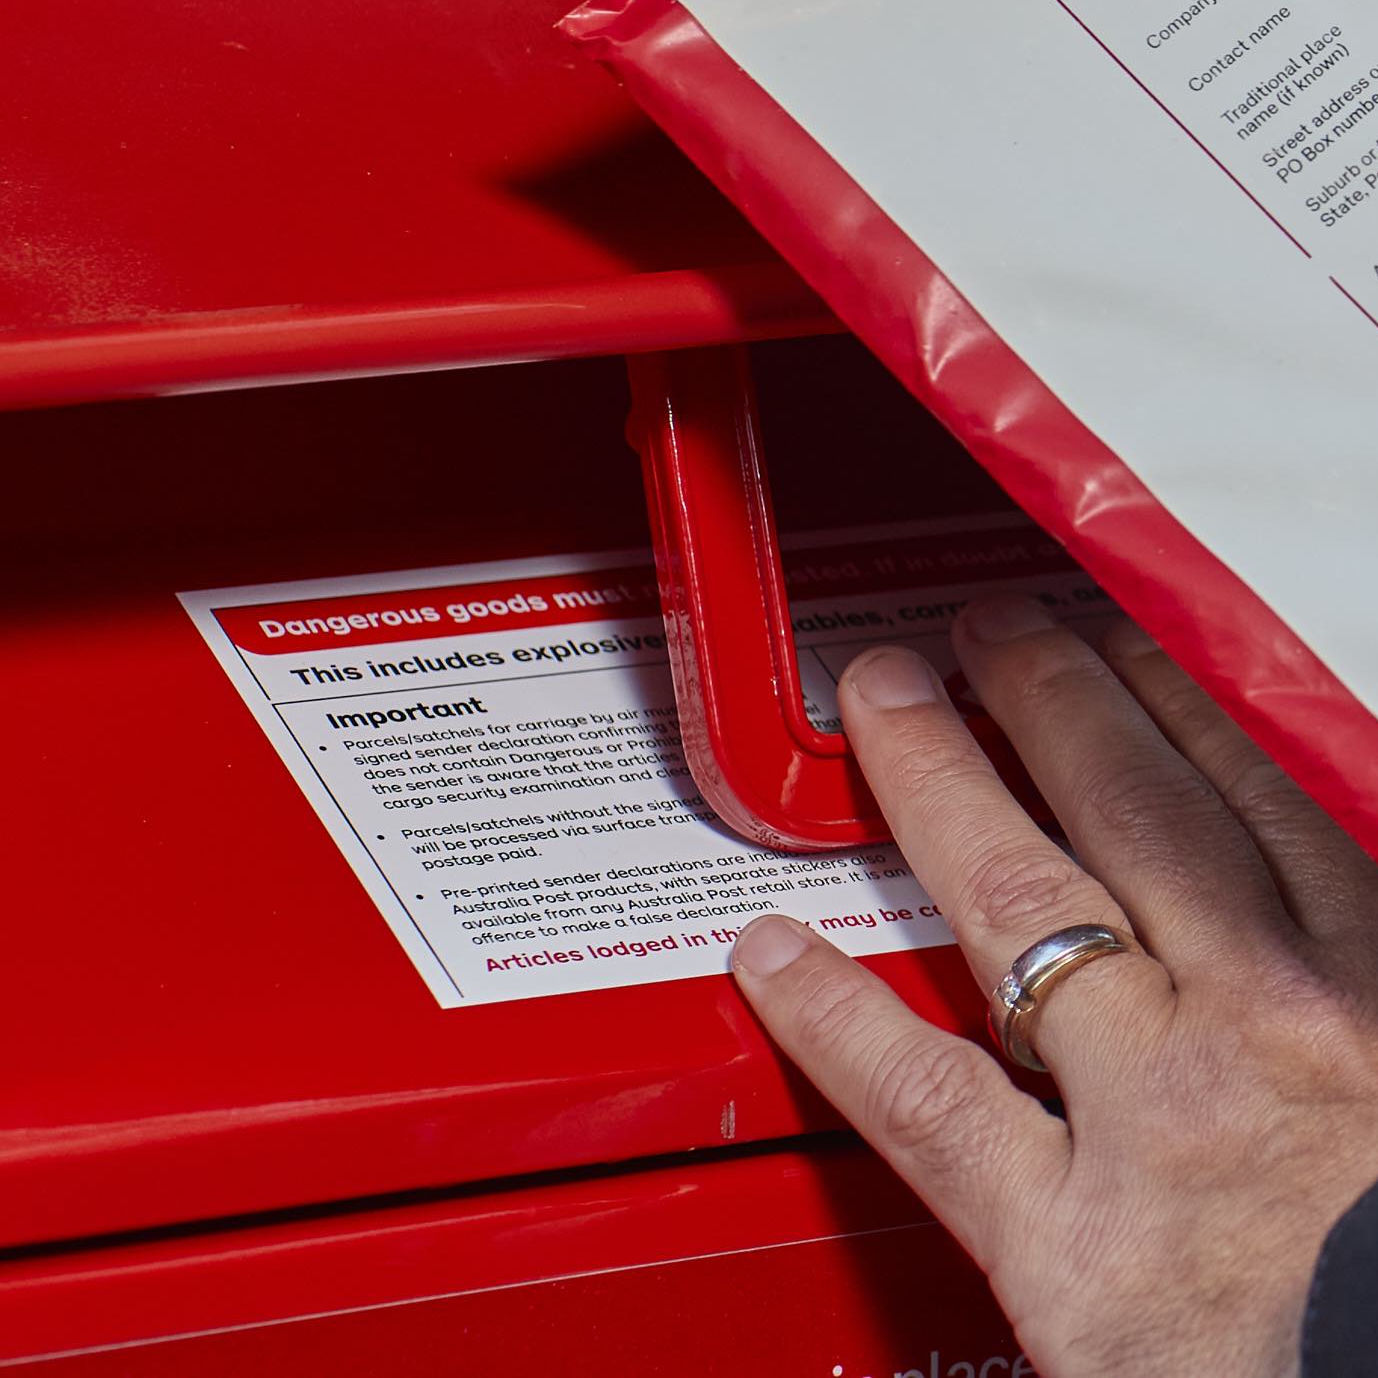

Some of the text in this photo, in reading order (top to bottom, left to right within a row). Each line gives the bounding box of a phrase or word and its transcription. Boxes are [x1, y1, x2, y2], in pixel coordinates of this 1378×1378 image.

[1188, 7, 1291, 91] Contact name
[1220, 26, 1342, 123] Traditional place
[1236, 43, 1350, 139] name (if known)
[1262, 124, 1313, 167] Street
[1311, 78, 1370, 127] address
[1276, 158, 1303, 183] PO
[1300, 134, 1335, 161] Box
[1305, 165, 1361, 211] Suburb
[1360, 149, 1377, 166] or
[1320, 190, 1370, 226] State,
[258, 606, 440, 638] Dangerous
[446, 593, 548, 623] goods
[552, 584, 635, 608] must
[289, 664, 363, 685] This
[365, 651, 505, 677] includes
[325, 696, 488, 729] Important
[342, 717, 587, 750] Parcels/satchels carriage
[353, 718, 669, 766] signed sender declaration confirming
[363, 746, 603, 779] does contain Dangerous
[405, 747, 681, 791] sender aware that articles
[382, 776, 616, 809] cargo security examination
[401, 794, 705, 839] Parcels/satchels without signed
[411, 818, 656, 854] will processed surface
[421, 846, 542, 871] postage paid.
[440, 859, 714, 899] Pre-printed sender declarations
[453, 855, 848, 915] Australia Post products, with separate stickers
[461, 876, 847, 930] available from Australia Post retail store.
[471, 900, 779, 945] offence make false declaration.
[486, 950, 584, 972] Articles
[586, 935, 679, 958] lodged
[680, 933, 708, 947] in
[819, 913, 877, 930] may
[878, 908, 914, 922] be
